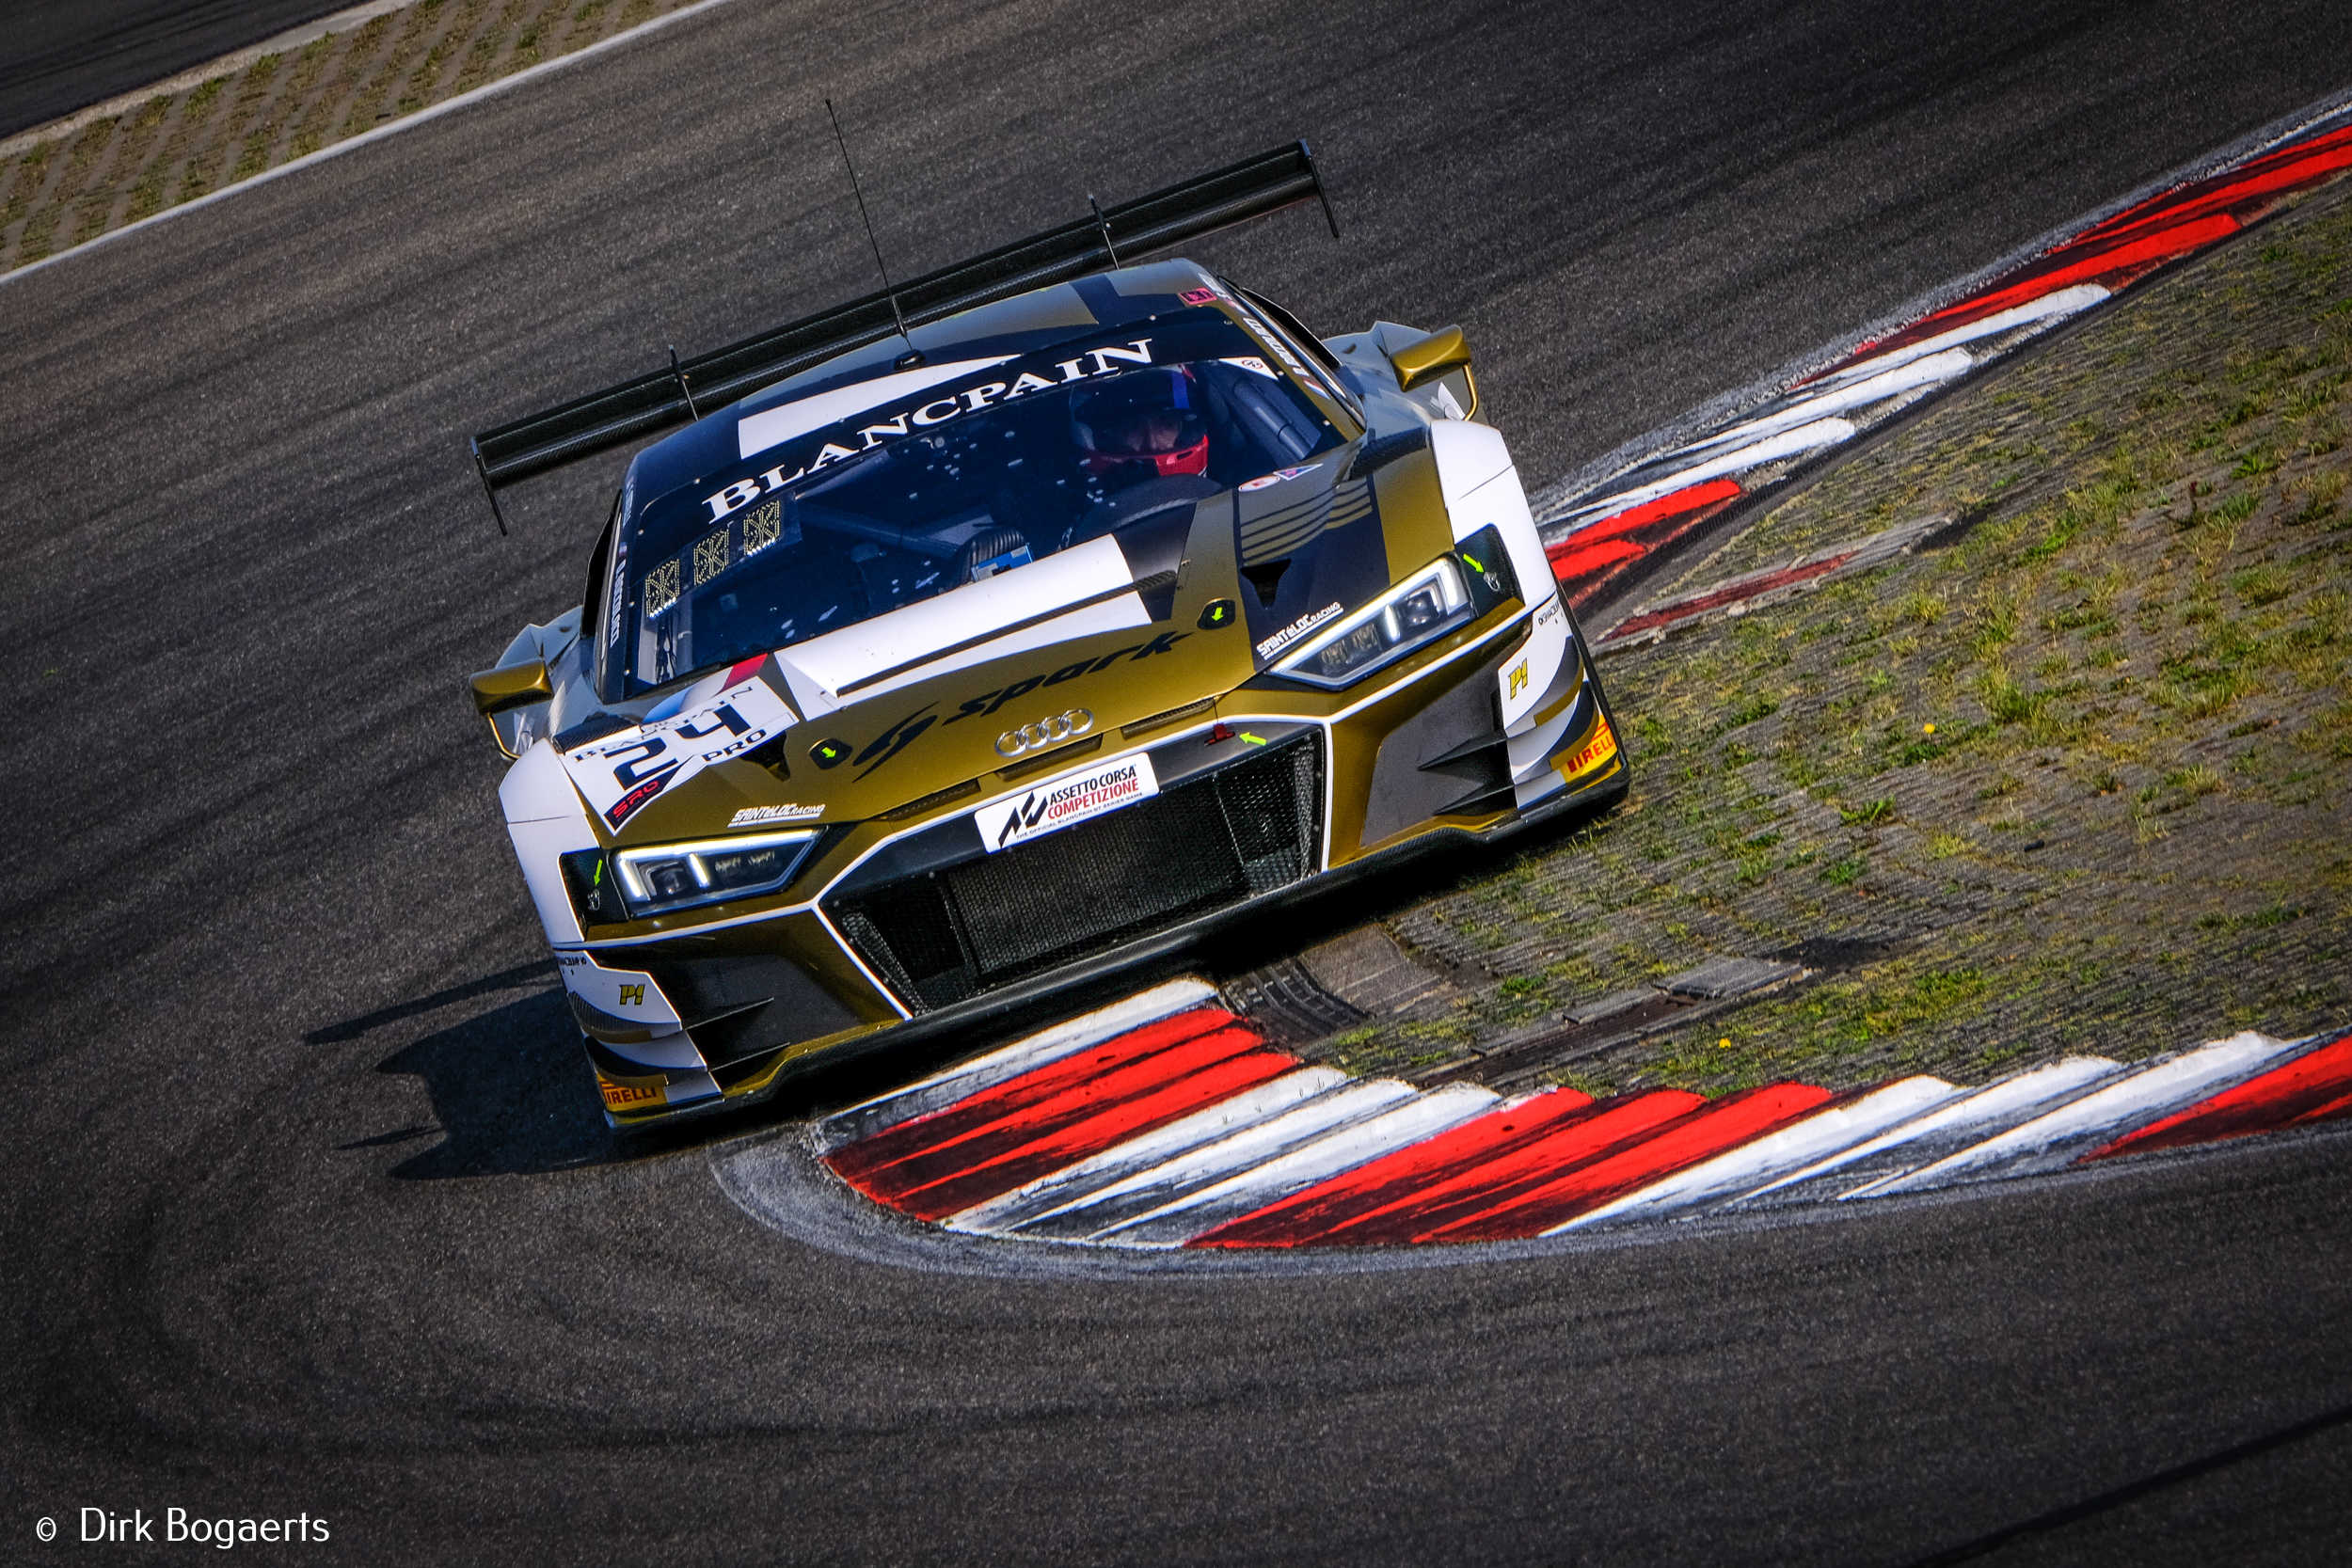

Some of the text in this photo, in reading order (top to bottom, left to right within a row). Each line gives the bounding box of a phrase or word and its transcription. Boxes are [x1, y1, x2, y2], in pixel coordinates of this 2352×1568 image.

[702, 339, 1152, 526] BLANCPAIN
[604, 704, 752, 791] 24
[702, 729, 767, 762] PRO
[1565, 728, 1615, 773] PIRELL
[612, 780, 660, 819] SRO
[1048, 778, 1139, 819] COMPETIZIONE
[1050, 765, 1137, 806] ASSETTO CORSA
